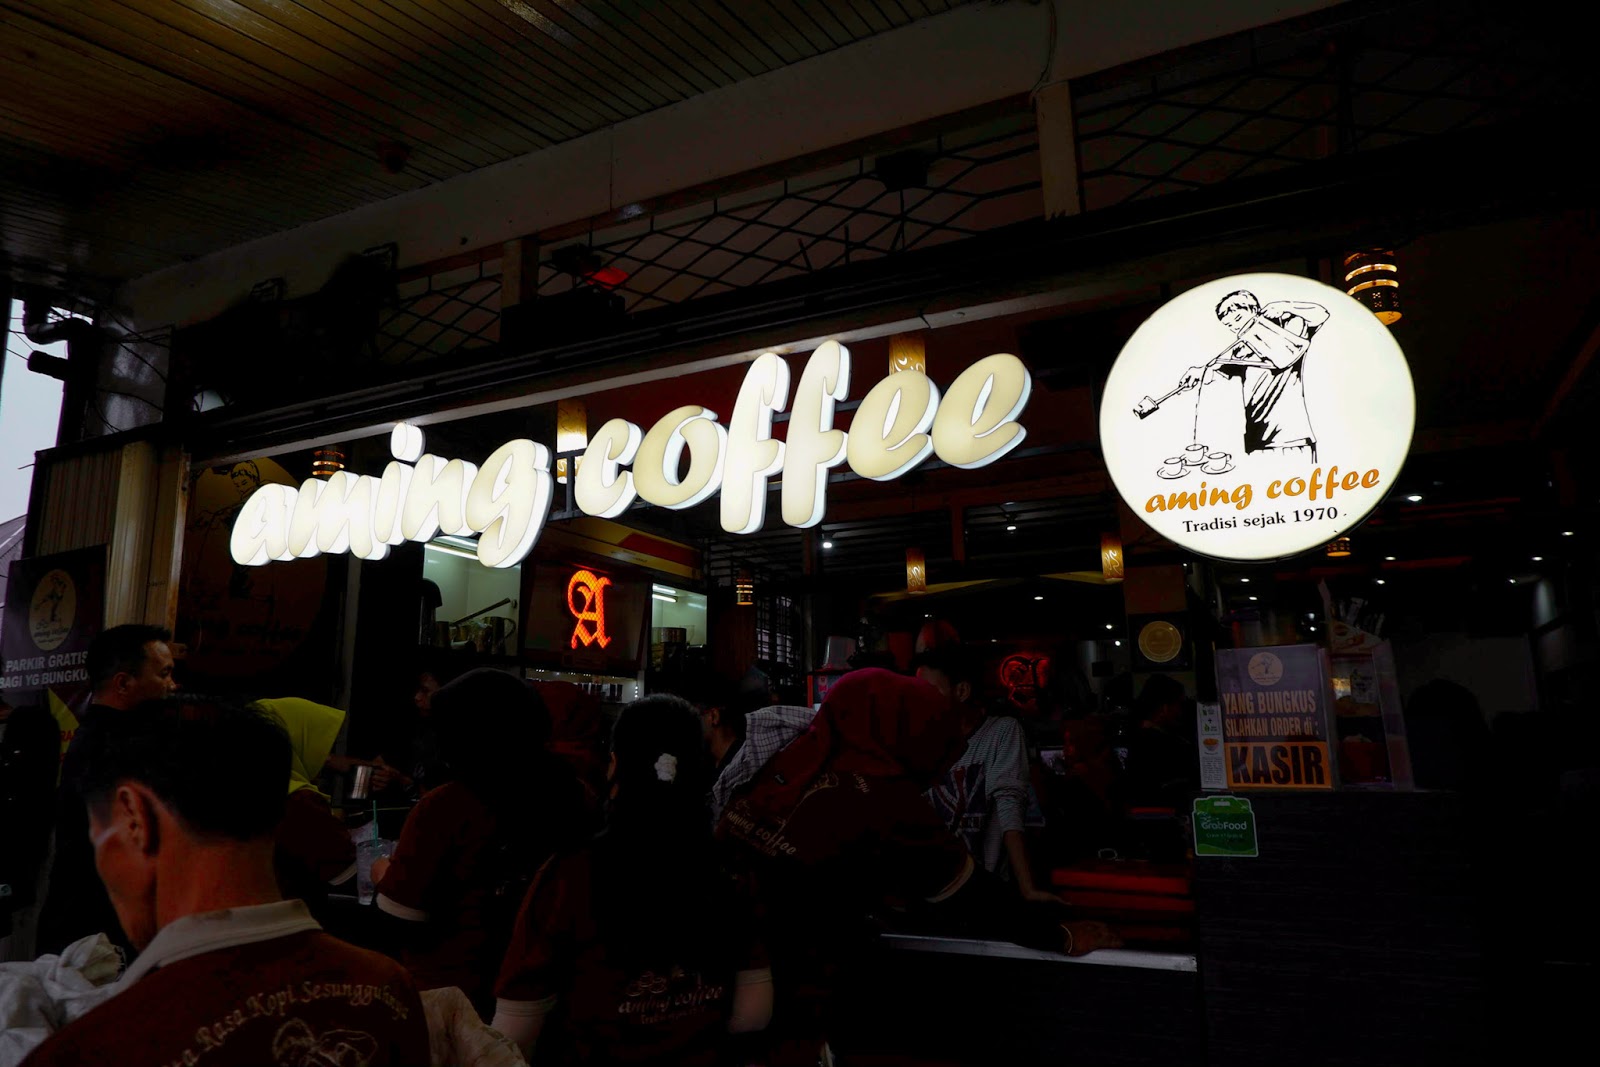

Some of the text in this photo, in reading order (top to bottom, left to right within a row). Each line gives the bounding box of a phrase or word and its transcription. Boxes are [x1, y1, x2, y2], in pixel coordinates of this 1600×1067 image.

[230, 341, 1033, 569] aming coffee
[1145, 465, 1380, 513] aming coffee
[1182, 506, 1338, 533] Tradisi sejak 1970
[5, 650, 89, 672] PARKIR GRATIS
[0, 668, 92, 688] BAGI YG BUNGKU
[1222, 689, 1317, 715] YANG BUNGKUS
[1225, 718, 1269, 738] SILAHKAN
[1270, 717, 1303, 736] ORDER
[1303, 716, 1313, 735] di
[1230, 745, 1325, 784] KASIR
[1200, 820, 1248, 830] GrabFood
